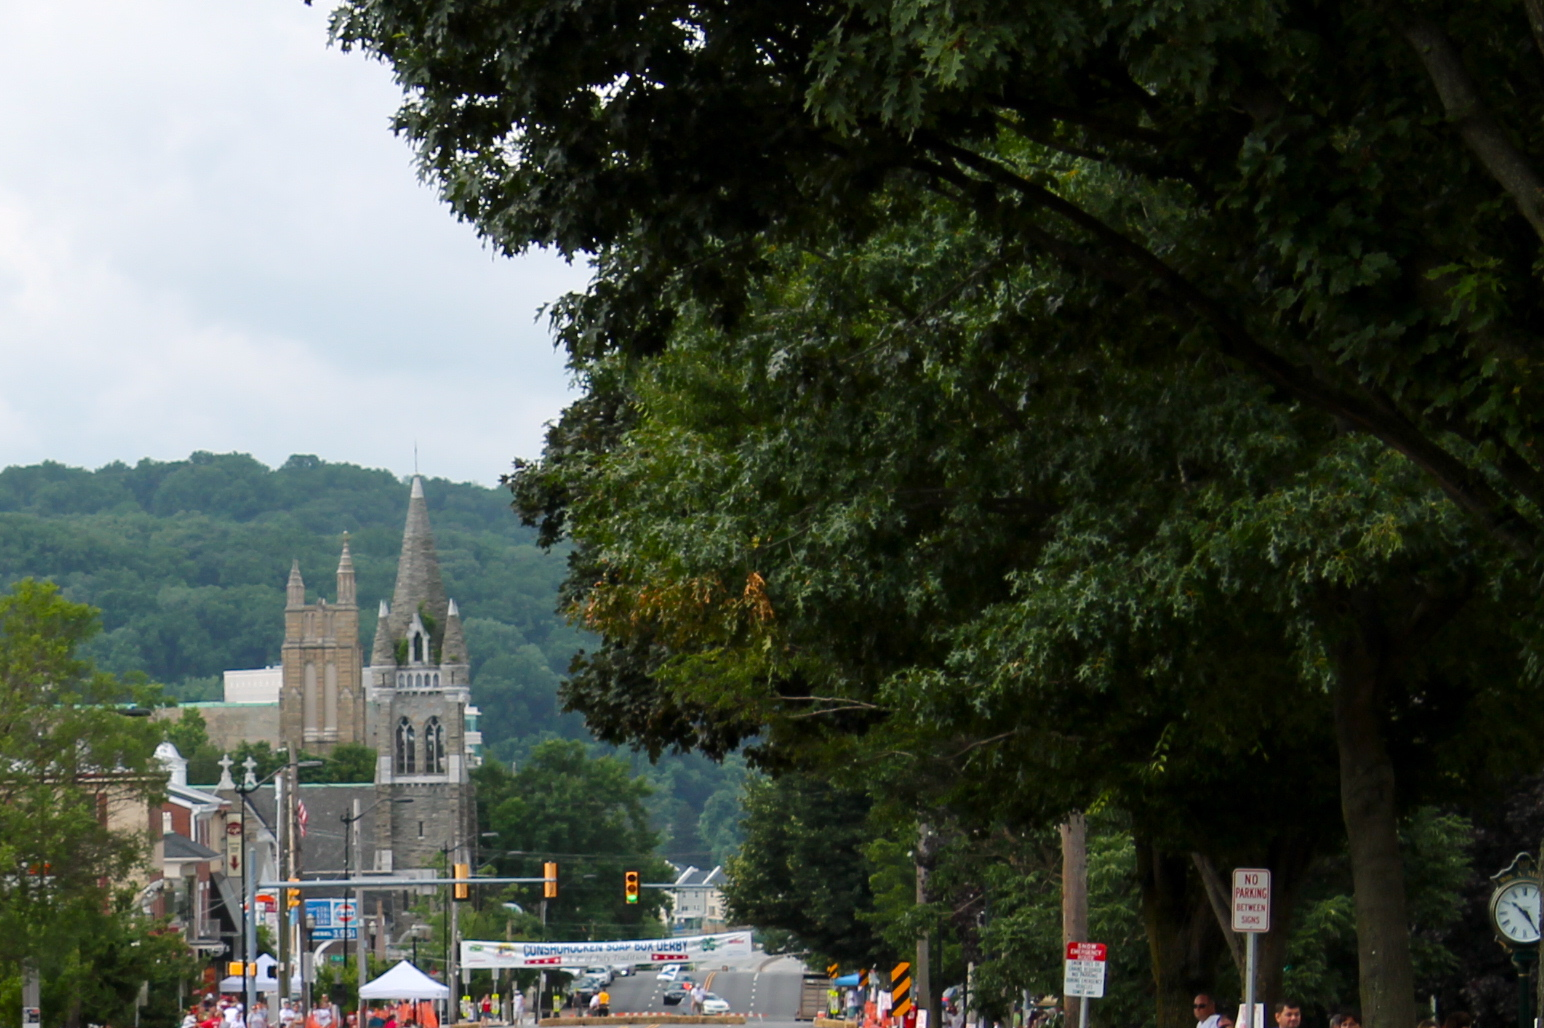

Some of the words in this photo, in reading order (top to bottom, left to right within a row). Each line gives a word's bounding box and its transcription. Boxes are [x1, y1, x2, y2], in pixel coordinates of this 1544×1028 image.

[1245, 874, 1258, 885] NO
[1236, 887, 1267, 899] PARKING
[1236, 903, 1266, 912] BETWEEN
[1242, 916, 1260, 924] SIGNS
[656, 939, 688, 953] DERBY
